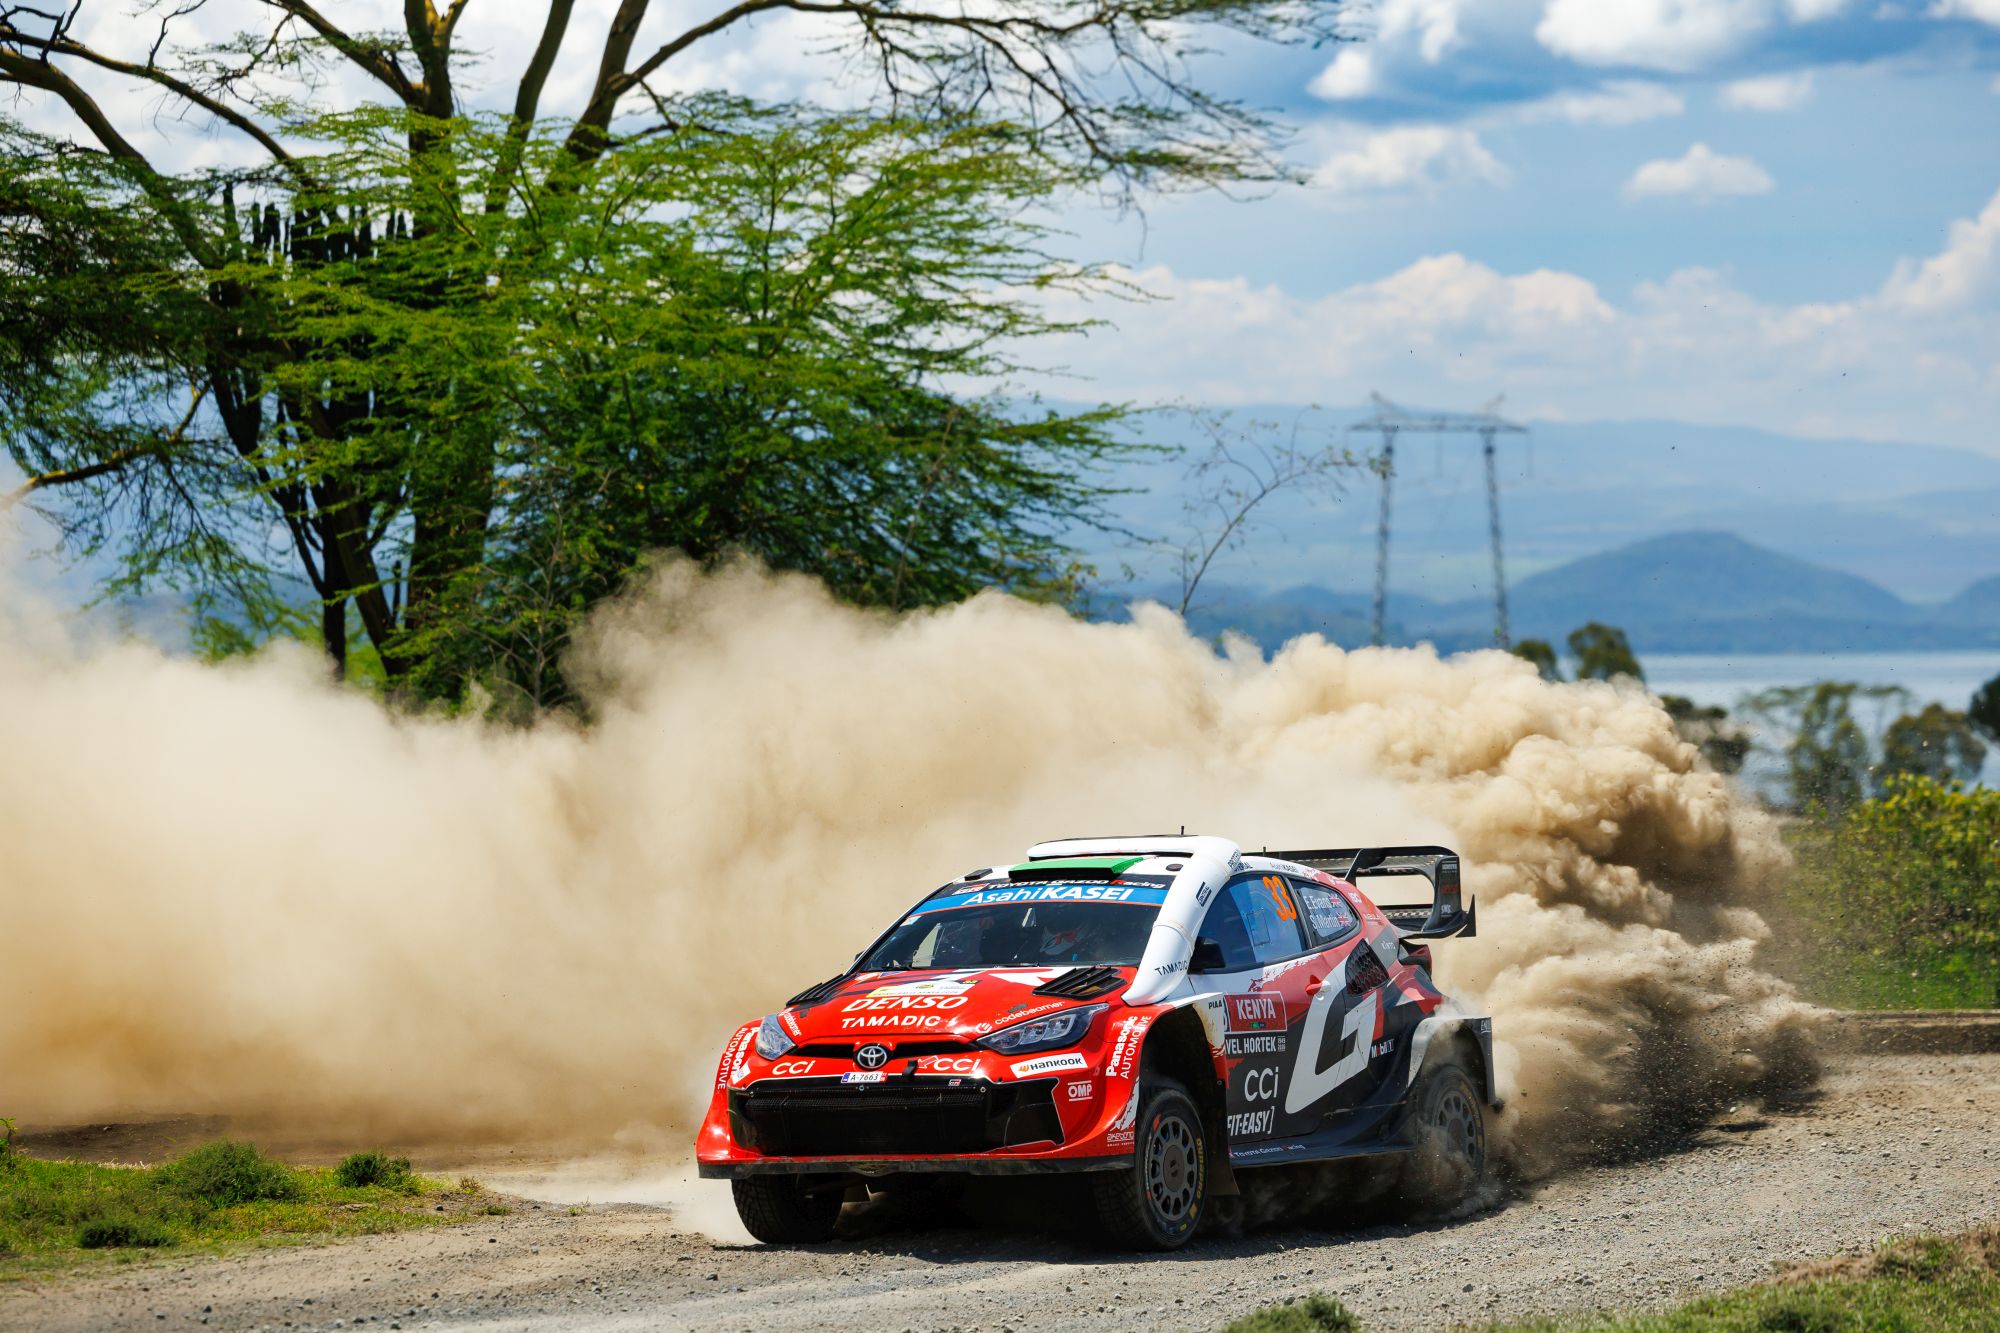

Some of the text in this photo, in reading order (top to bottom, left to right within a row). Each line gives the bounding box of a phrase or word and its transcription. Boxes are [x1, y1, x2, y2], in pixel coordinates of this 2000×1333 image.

[1110, 879, 1166, 889] Racing
[962, 886, 1135, 906] AsahiKASEI
[1262, 875, 1297, 921] 33
[841, 996, 969, 1013] DENSO
[995, 1001, 1065, 1025] codebeamer
[1208, 1000, 1222, 1010] PIAA
[1236, 997, 1276, 1020] KENYA
[841, 1015, 942, 1028] TAMADIC
[1106, 1016, 1138, 1077] Panasonic
[1120, 1016, 1151, 1079] AUTOMOTIVE
[1243, 1036, 1277, 1053] HORTEK
[718, 1027, 748, 1090] AUTOMOTIVE
[850, 1073, 879, 1082] A-7663
[1068, 1084, 1093, 1097] OMP
